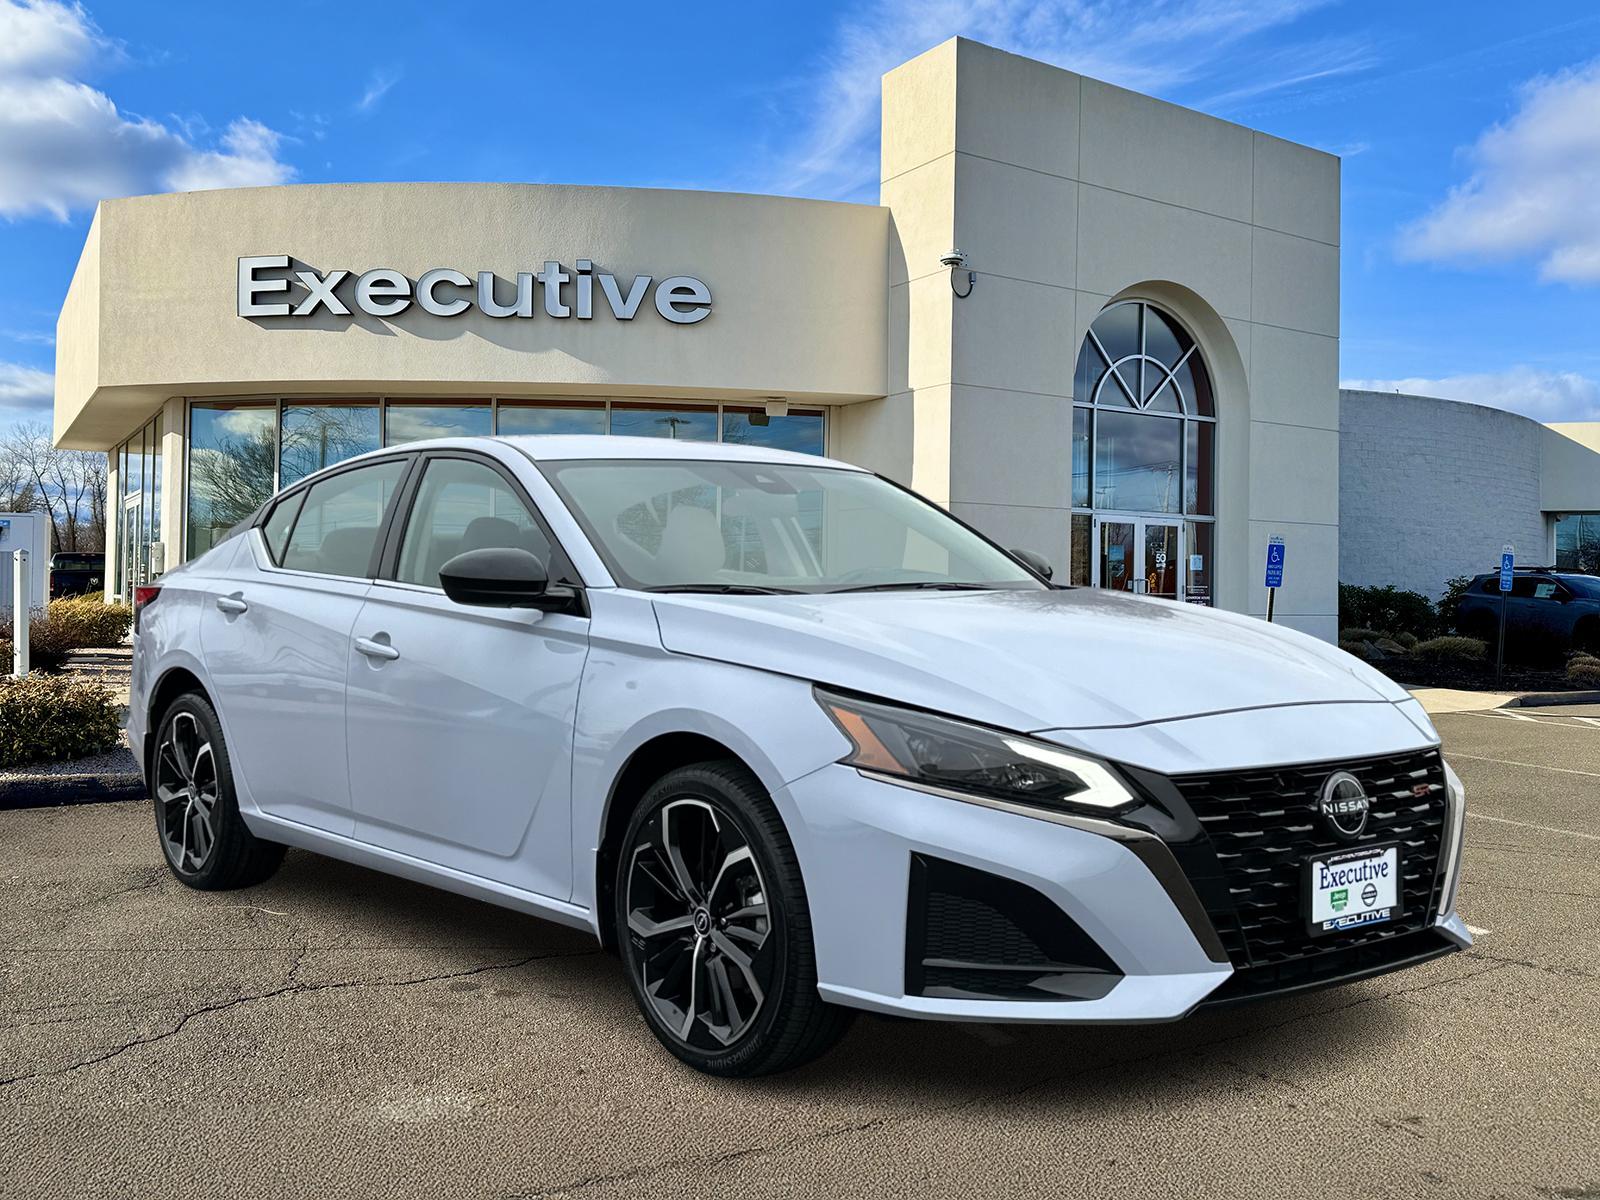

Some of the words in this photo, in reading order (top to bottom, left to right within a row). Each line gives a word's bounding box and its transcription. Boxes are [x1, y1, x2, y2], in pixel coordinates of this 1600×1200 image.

[237, 255, 713, 324] Executive
[1322, 799, 1369, 814] NISSAN
[1319, 859, 1389, 890] Executive
[1323, 908, 1390, 931] EXECUTIVE
